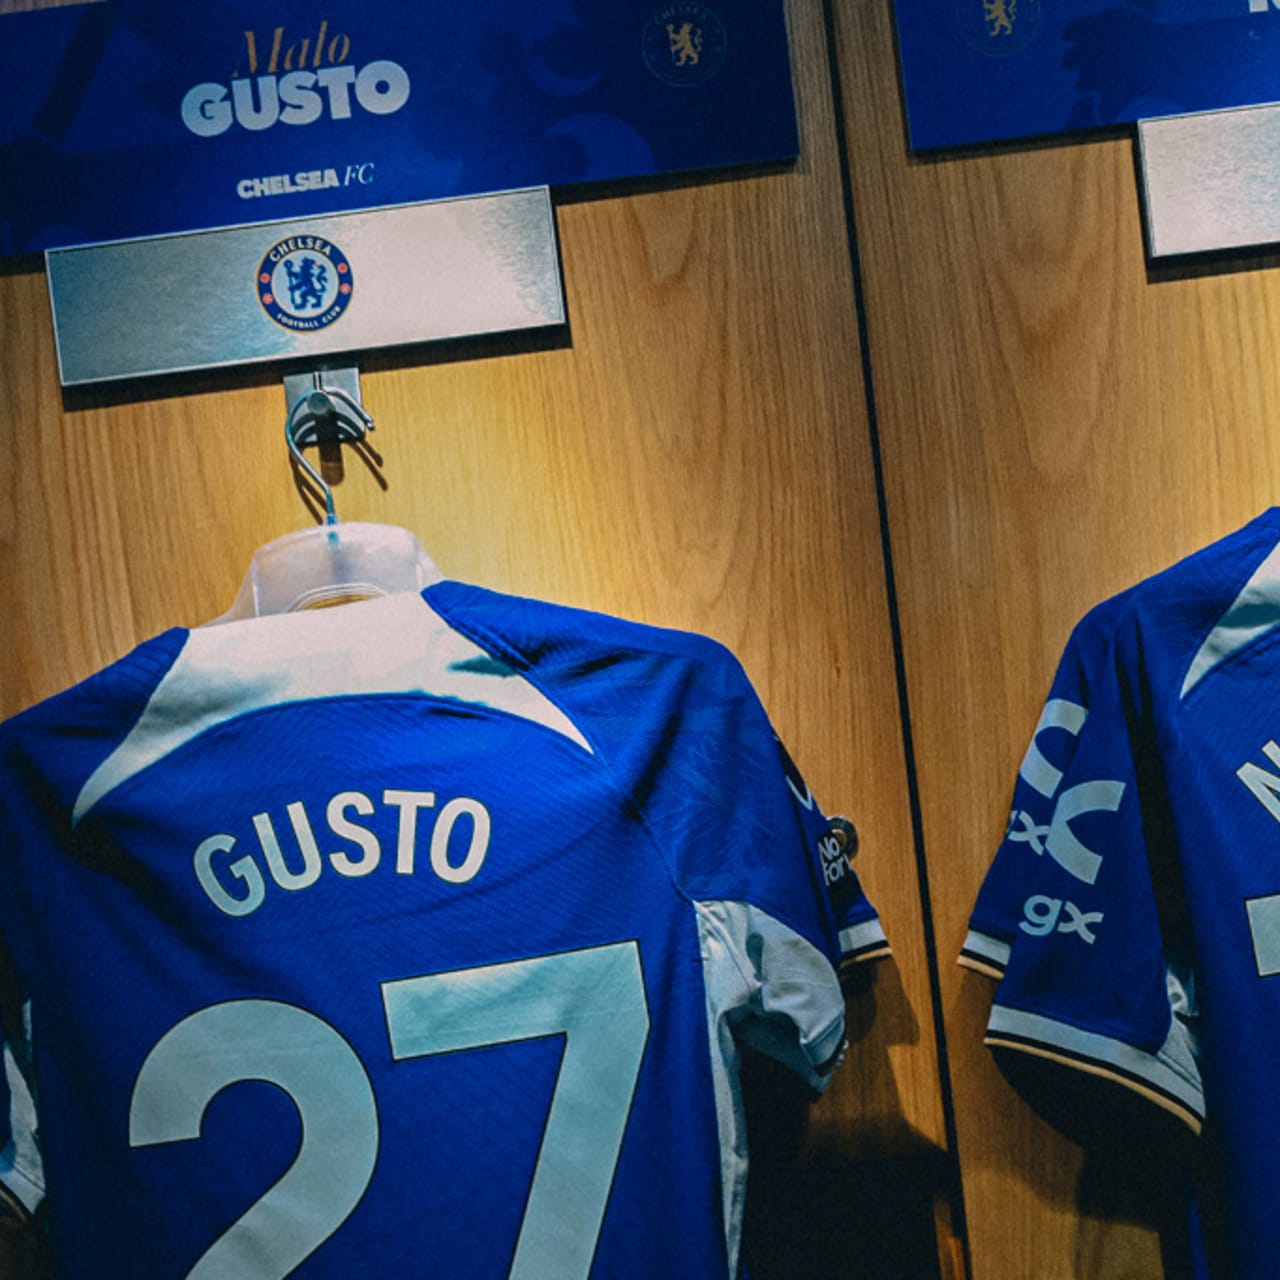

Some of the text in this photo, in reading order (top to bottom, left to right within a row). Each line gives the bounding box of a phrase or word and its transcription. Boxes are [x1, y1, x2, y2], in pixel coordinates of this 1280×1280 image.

[231, 20, 350, 78] Malo
[181, 60, 410, 137] GUSTO
[237, 162, 374, 199] CHELSEA FC
[269, 238, 331, 262] CHELSEA
[193, 789, 491, 917] GUSTO
[817, 836, 840, 862] No
[129, 940, 650, 1280] 27
